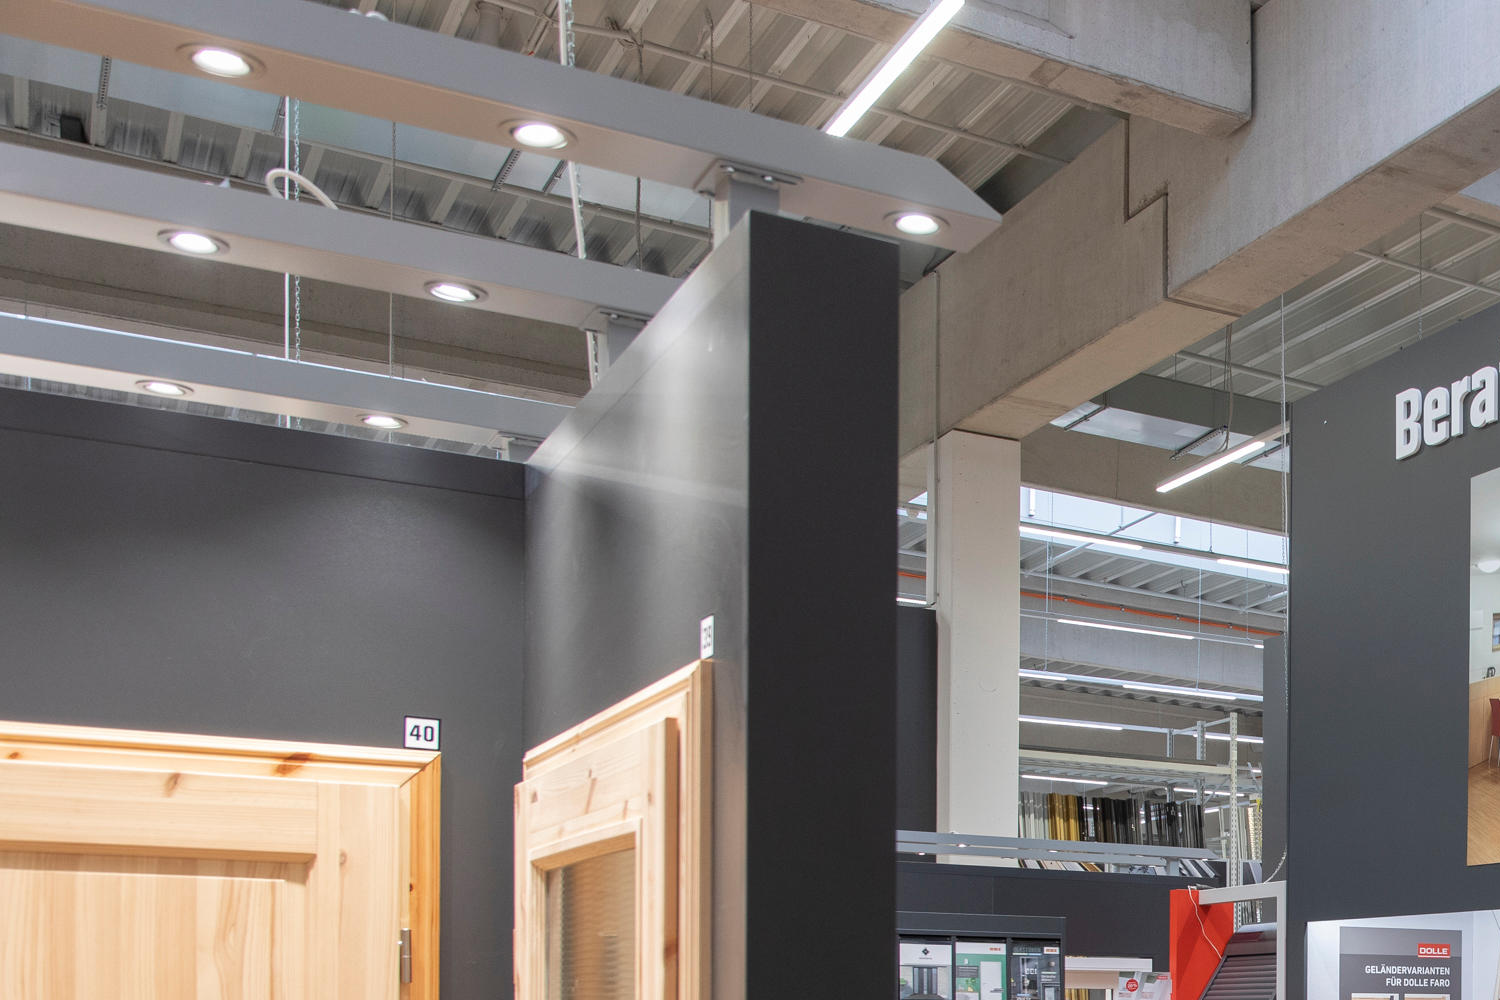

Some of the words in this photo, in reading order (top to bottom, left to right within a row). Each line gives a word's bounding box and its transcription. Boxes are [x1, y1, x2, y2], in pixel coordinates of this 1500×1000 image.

[410, 725, 434, 742] 40
[1419, 947, 1448, 955] DOLLE
[1364, 964, 1451, 975] GELÄNDERVARIANTEN
[1385, 976, 1402, 987] FÜR
[1403, 978, 1429, 987] DOLLE
[1430, 979, 1451, 988] FARO
